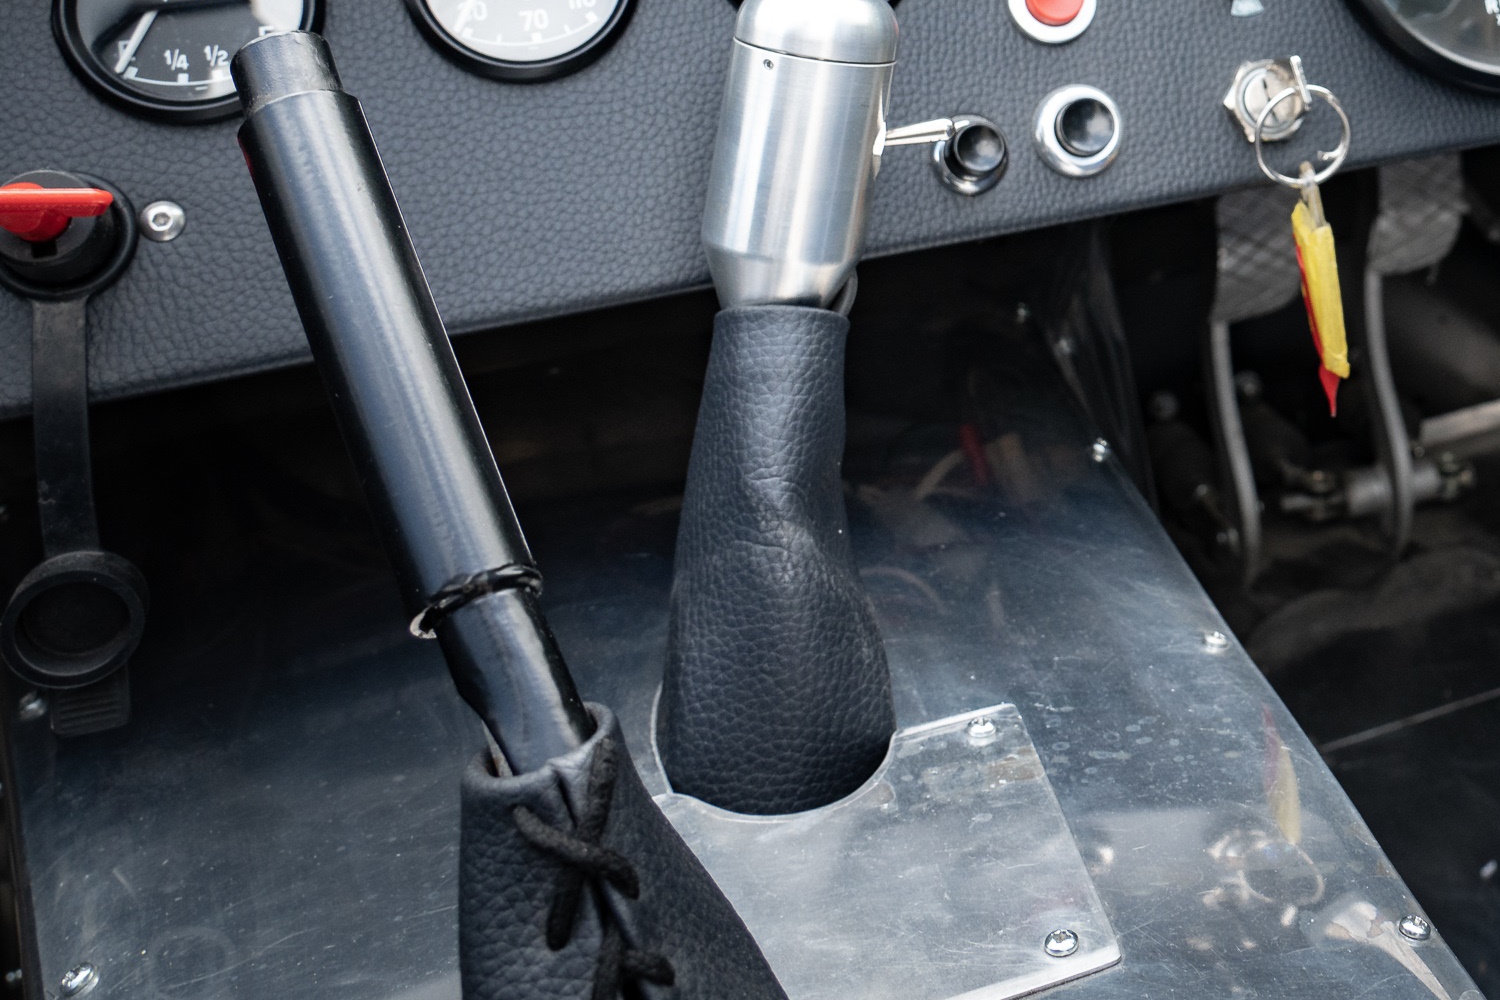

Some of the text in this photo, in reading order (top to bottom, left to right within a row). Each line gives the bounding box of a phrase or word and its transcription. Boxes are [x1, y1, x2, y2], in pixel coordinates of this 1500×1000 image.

[518, 9, 549, 31] 70
[163, 48, 190, 71] 1/4
[204, 44, 230, 67] 1/2
